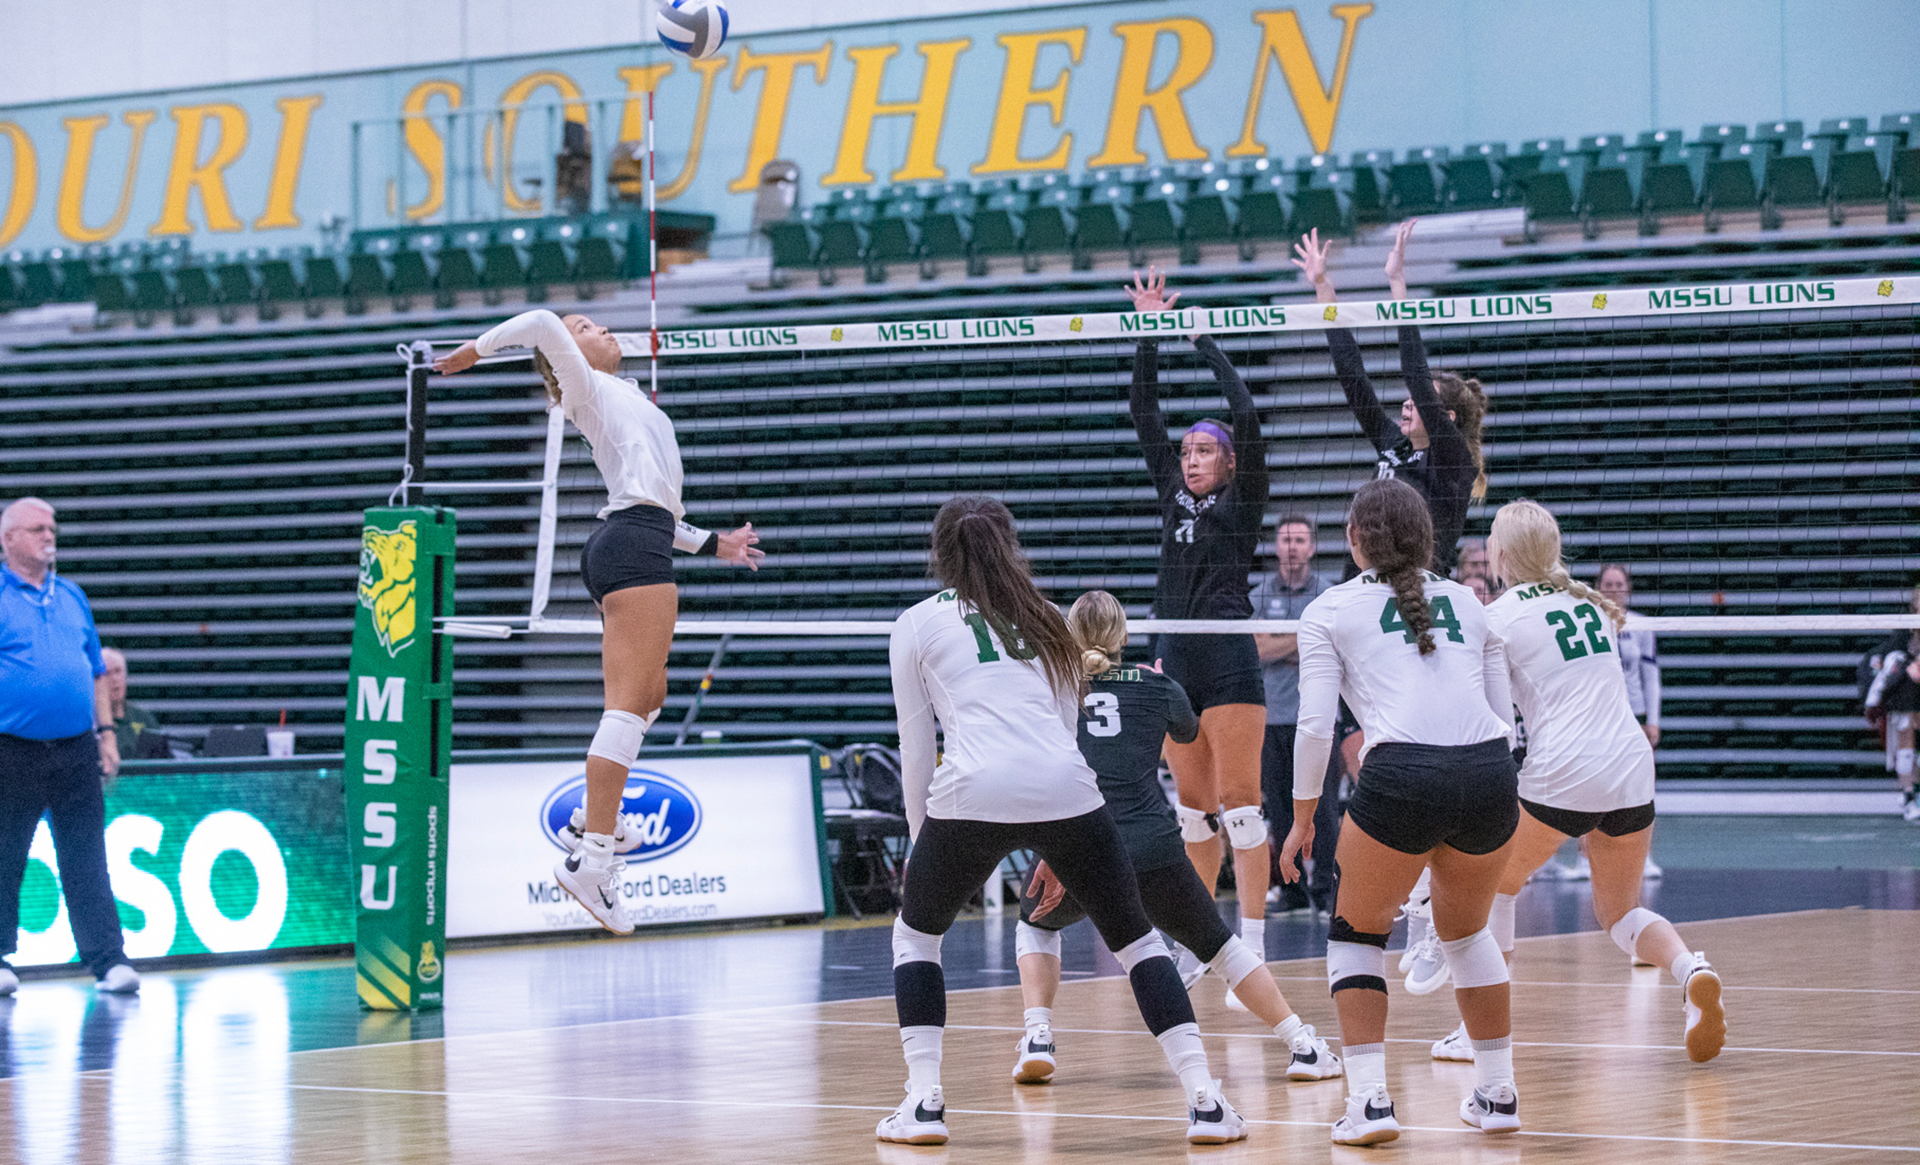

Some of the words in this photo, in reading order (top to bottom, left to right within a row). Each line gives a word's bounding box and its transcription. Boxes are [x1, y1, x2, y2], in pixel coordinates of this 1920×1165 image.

[386, 3, 1374, 219] SOUTHERN
[1376, 299, 1456, 321] MSSU
[1471, 295, 1553, 317] LIONS
[1649, 286, 1732, 310] MSSU
[1749, 282, 1835, 305] LIONS
[729, 328, 798, 347] LIONS
[878, 322, 949, 342] MSSU
[962, 318, 1035, 339] LIONS
[1120, 311, 1195, 332] MSSU
[1209, 307, 1286, 328] LIONS
[1379, 595, 1465, 645] 44
[1545, 603, 1612, 662] 22
[1083, 692, 1122, 737] 3
[427, 805, 438, 858] sports
[425, 861, 437, 925] imports
[617, 875, 653, 899] ord
[658, 872, 726, 896] Dealers
